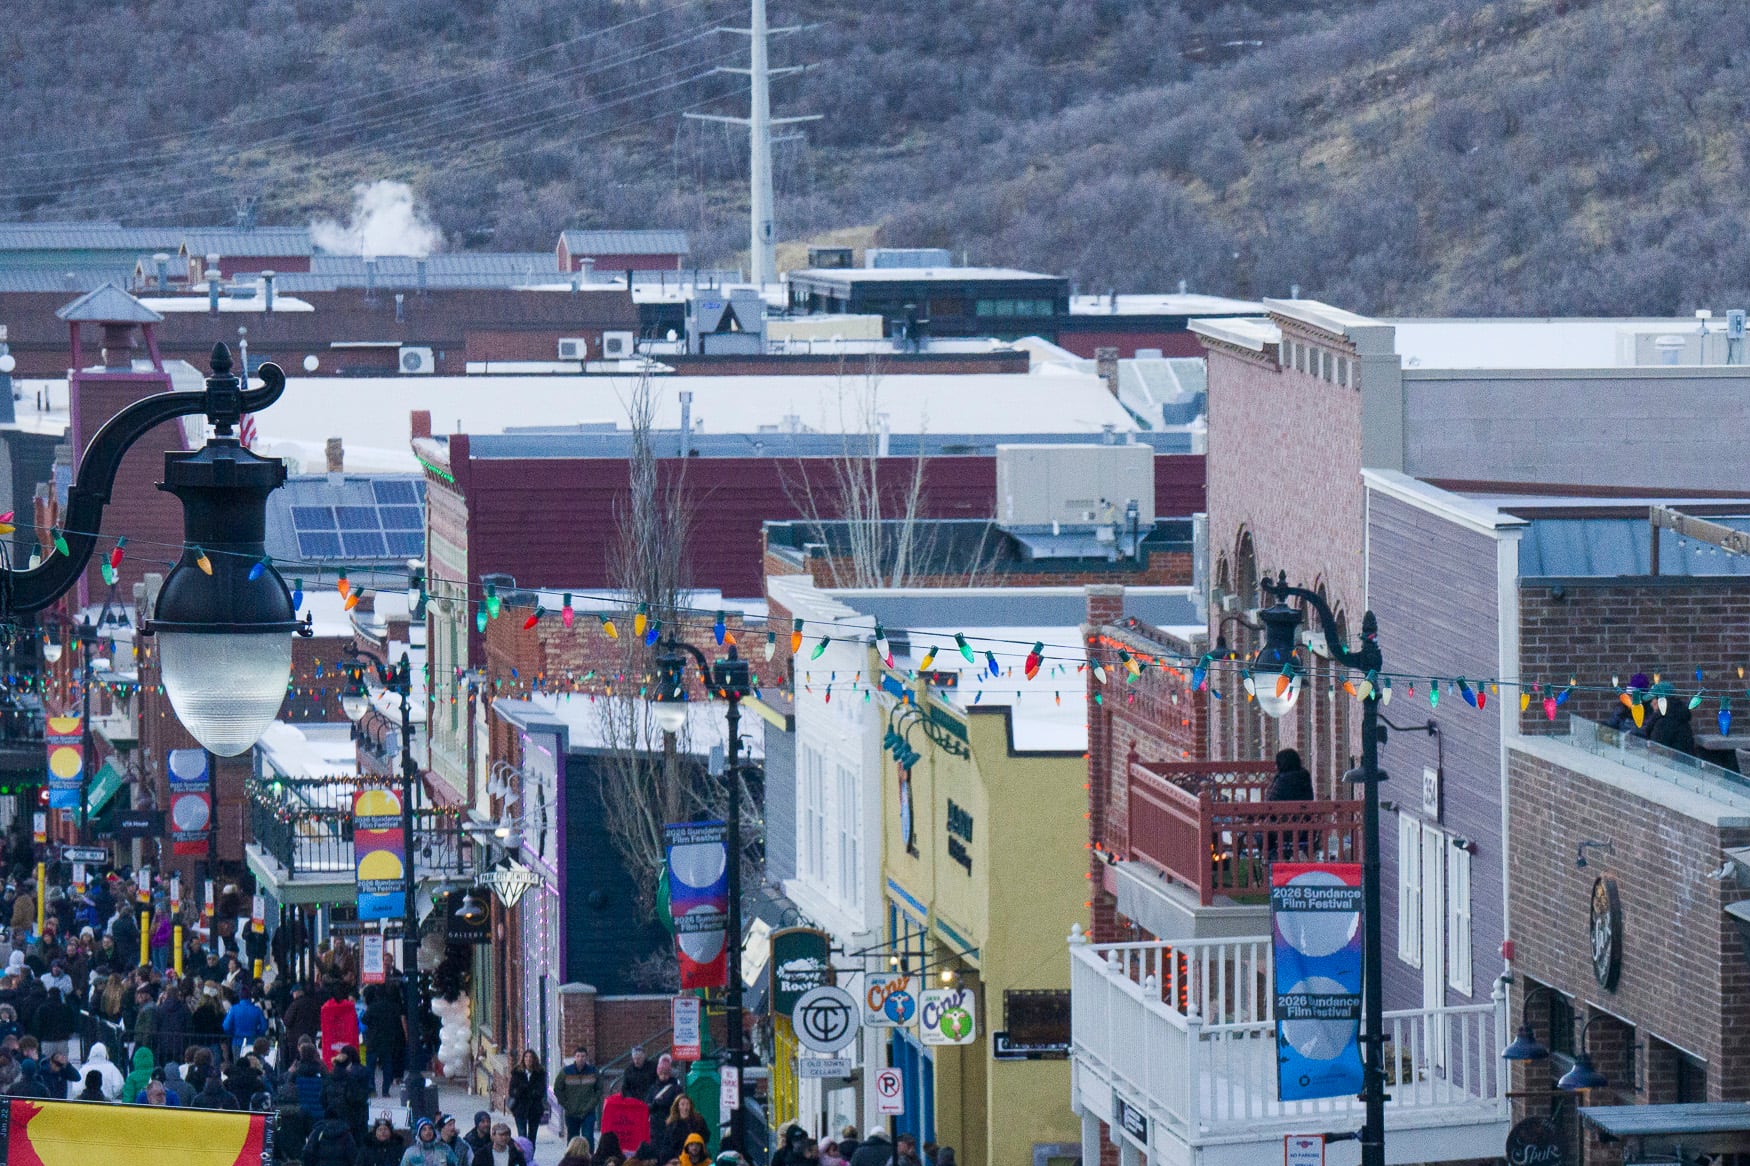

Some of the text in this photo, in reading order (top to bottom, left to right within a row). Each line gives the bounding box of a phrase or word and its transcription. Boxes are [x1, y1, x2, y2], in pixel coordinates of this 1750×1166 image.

[1273, 888, 1361, 899] 2026 Sundance
[1282, 899, 1353, 909] Film Festival
[1278, 996, 1360, 1007] 2026 Sundance
[1287, 1007, 1312, 1017] Film
